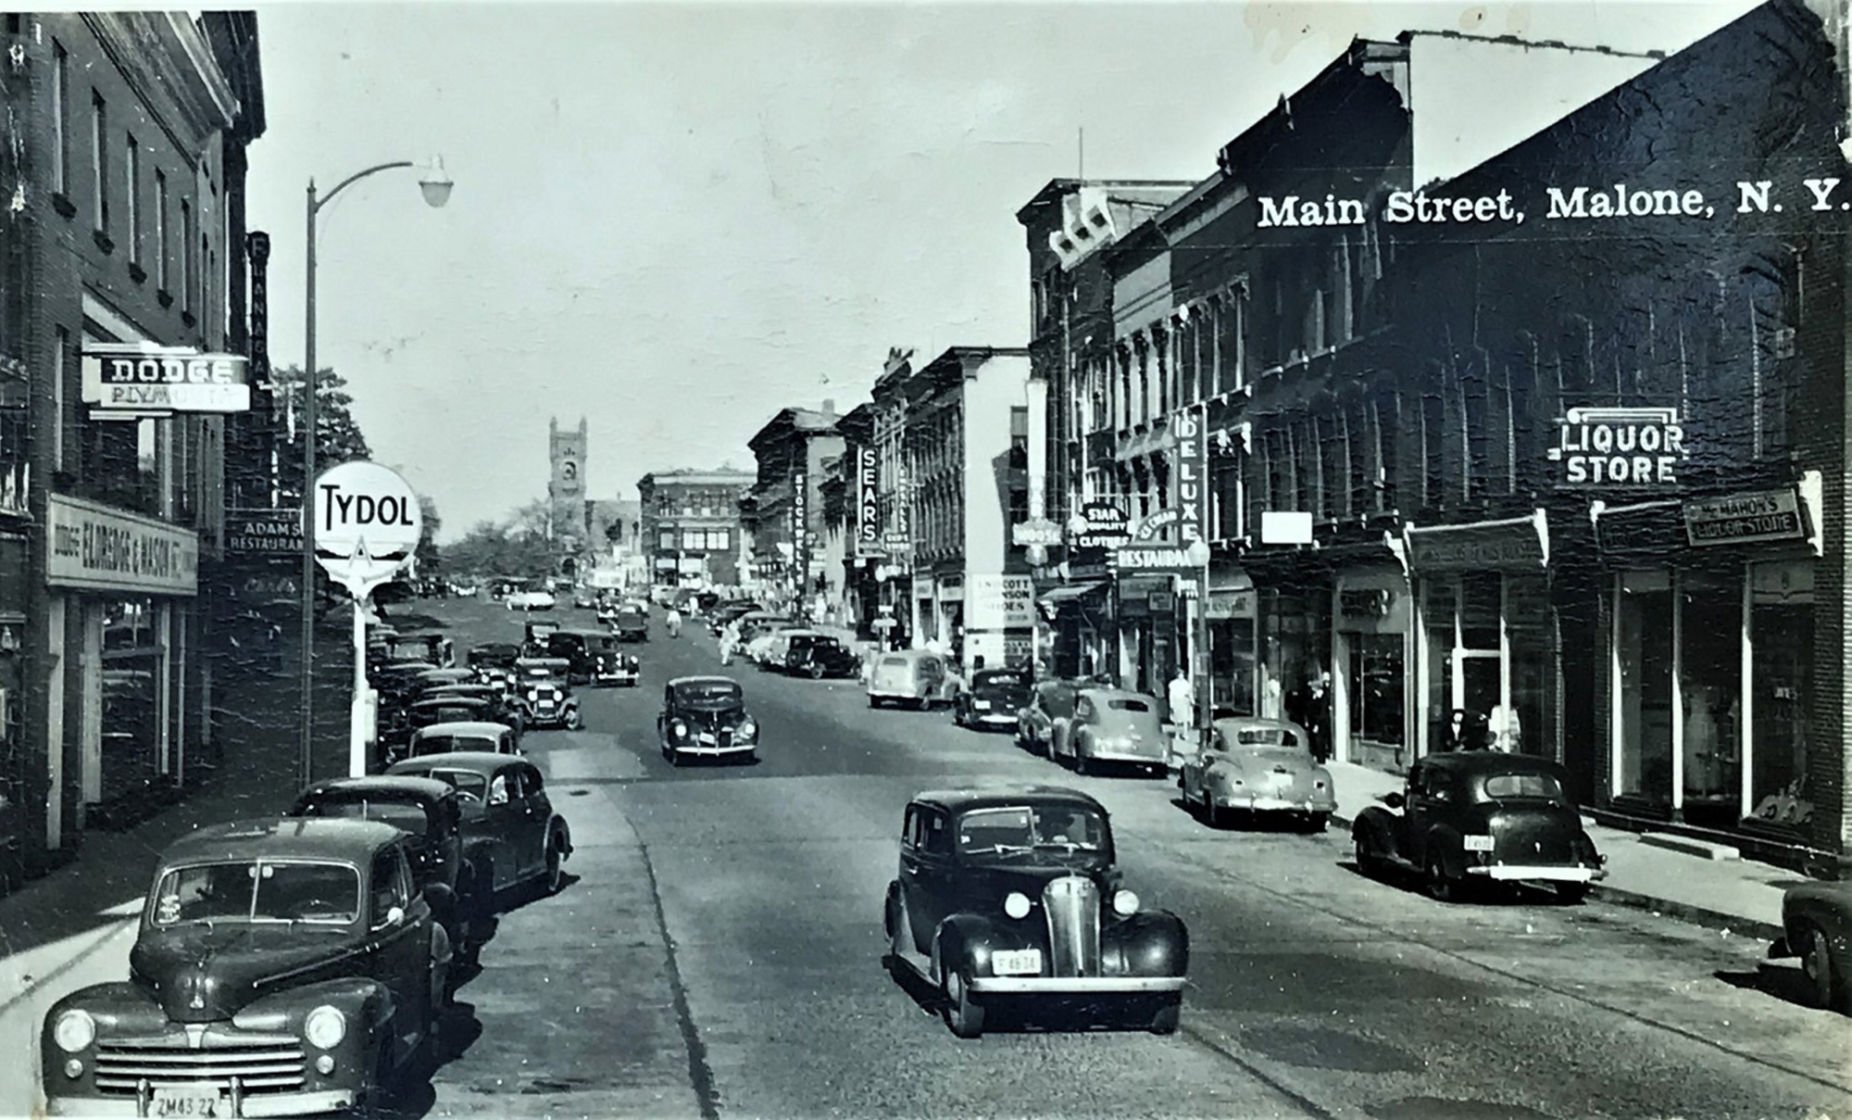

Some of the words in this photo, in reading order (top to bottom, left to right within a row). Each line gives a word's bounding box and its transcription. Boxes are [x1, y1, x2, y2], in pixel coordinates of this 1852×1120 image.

[111, 359, 233, 383] DODGE
[1561, 424, 1684, 454] LIQUOR
[1181, 420, 1199, 541] DELUXE
[1567, 455, 1677, 483] STORE
[863, 449, 877, 541] SEARS
[1088, 508, 1120, 521] STAR
[244, 522, 301, 537] ADAMS
[230, 536, 305, 550] RESTAURAN
[1118, 549, 1193, 567] RESTAURAN
